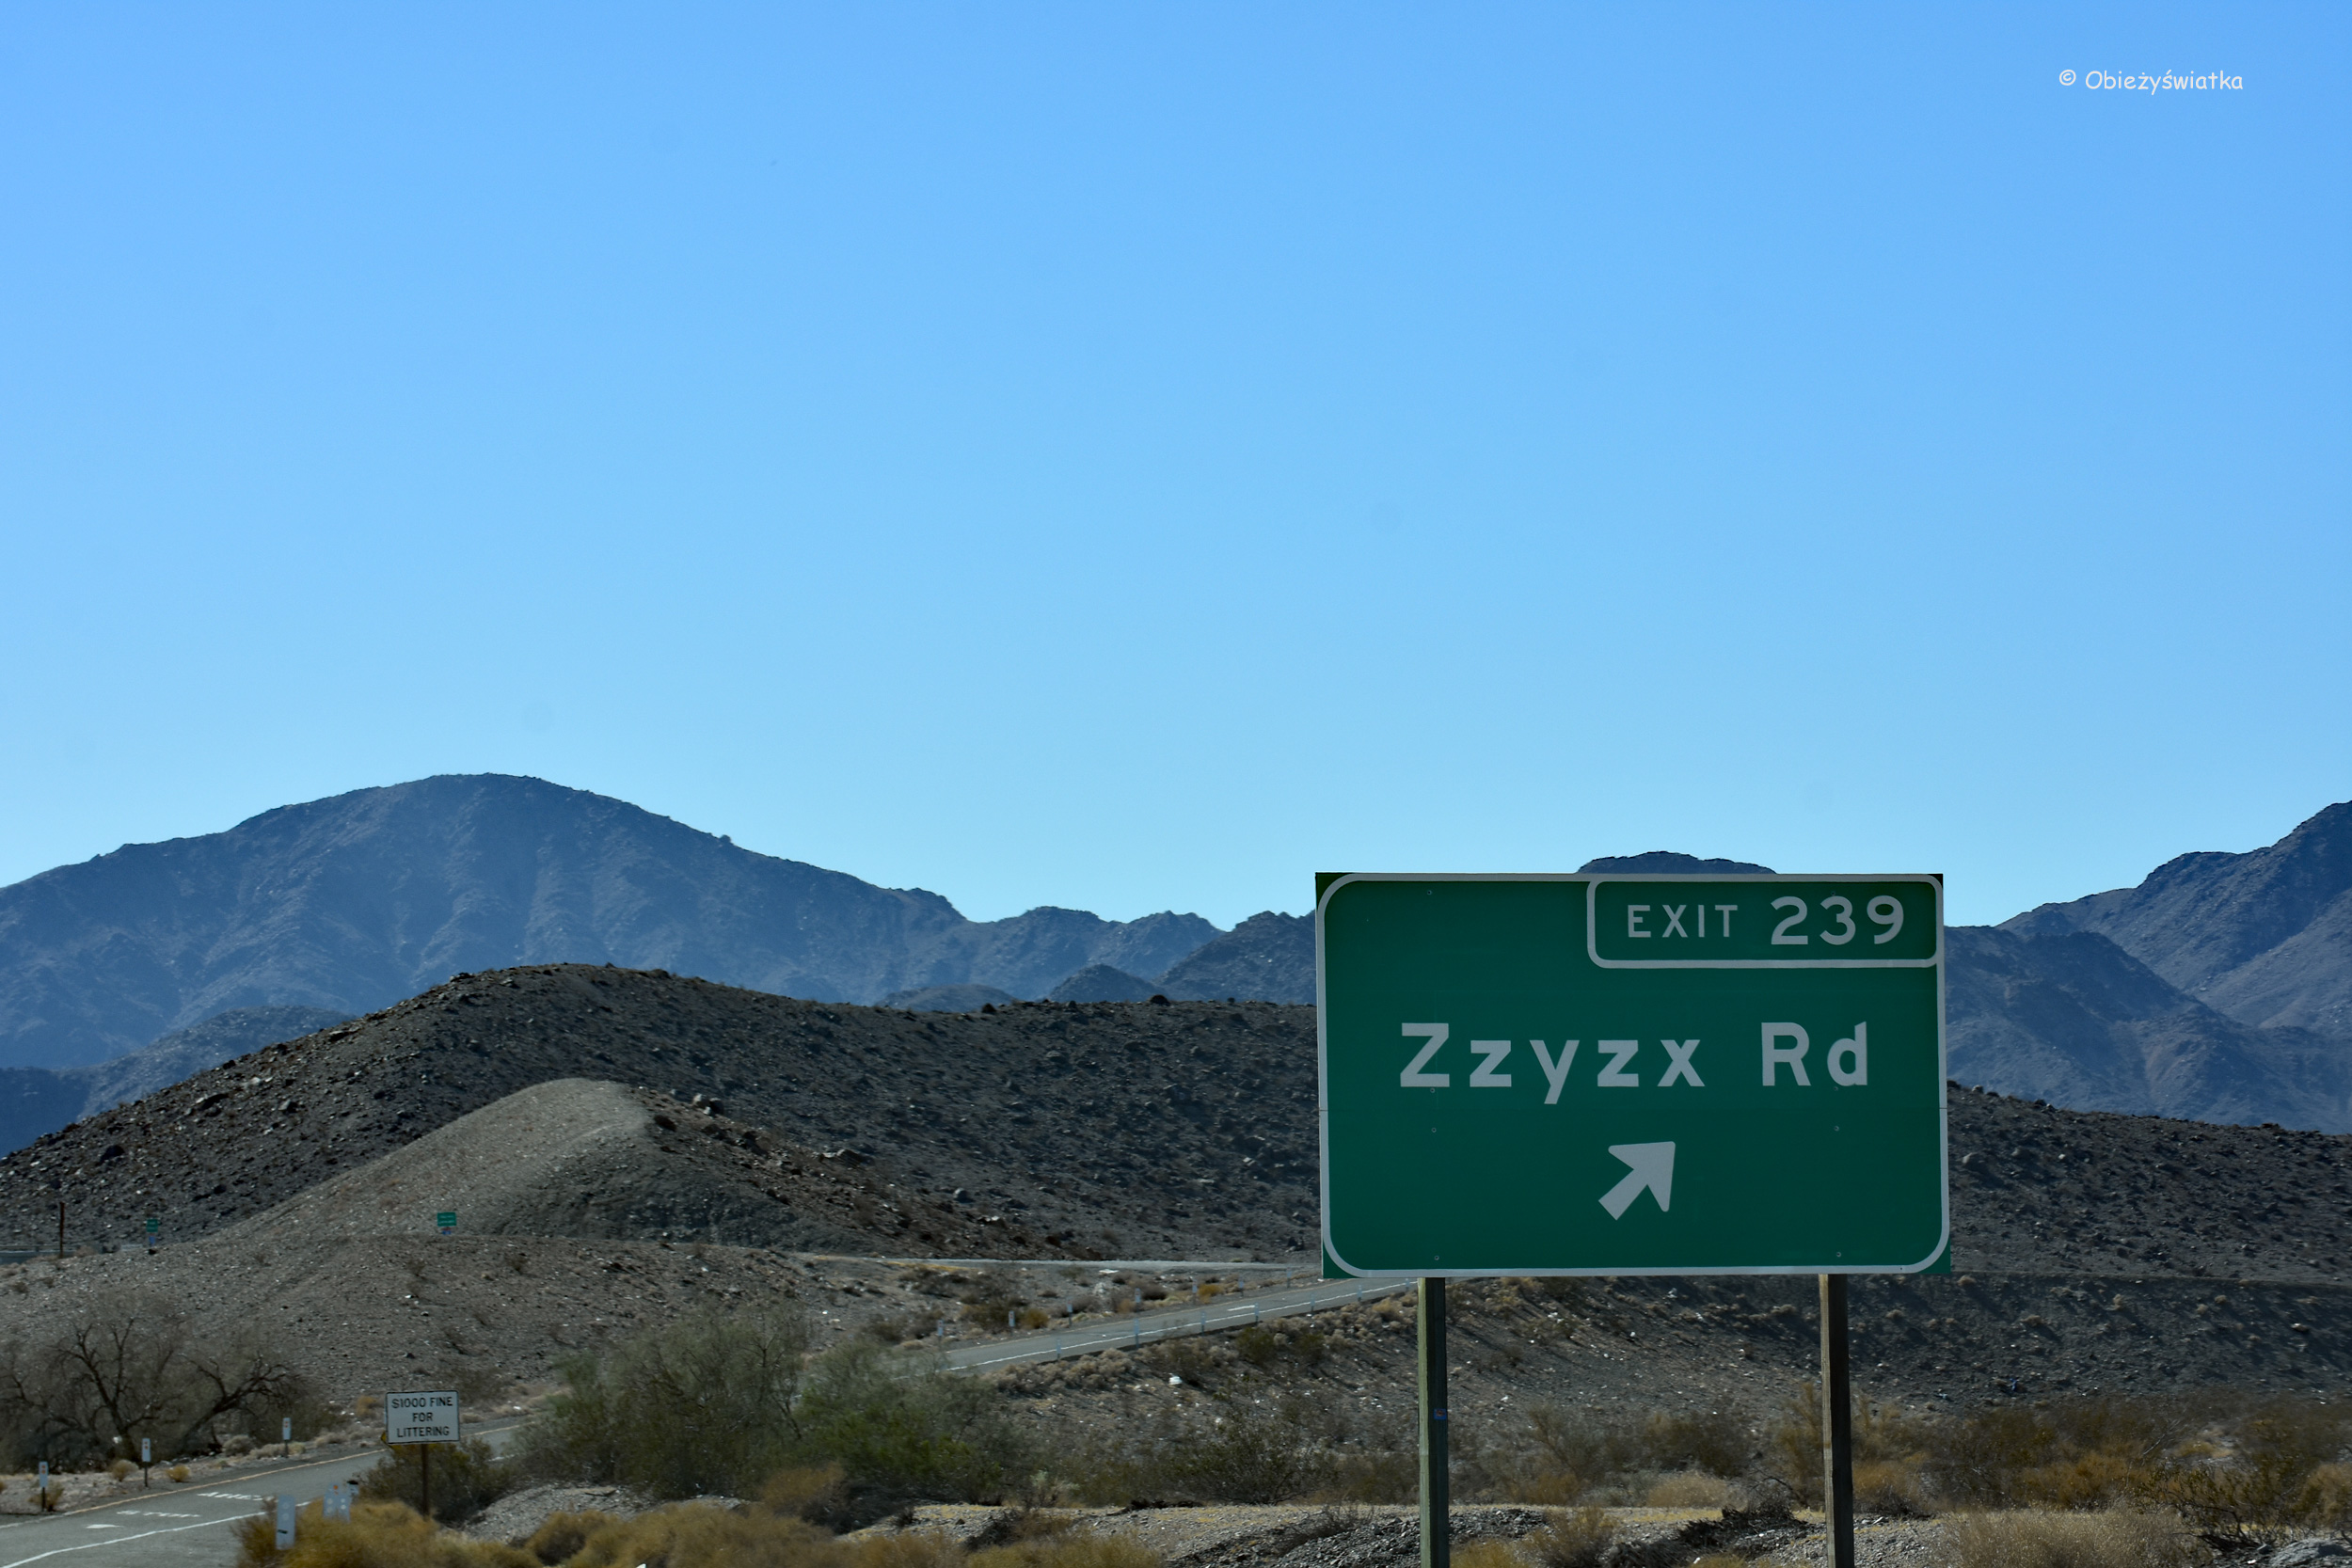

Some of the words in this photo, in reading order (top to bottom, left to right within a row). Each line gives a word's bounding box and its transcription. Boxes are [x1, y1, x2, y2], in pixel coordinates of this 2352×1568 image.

[1629, 906, 1737, 937] EXIT
[1772, 897, 1902, 944] 239
[1401, 1023, 1704, 1103] Zzyzx
[1762, 1022, 1867, 1085] Rd
[391, 1398, 426, 1408] $1000
[430, 1397, 453, 1407] FINE
[413, 1413, 433, 1422] FOR
[397, 1427, 450, 1437] LITTERING
